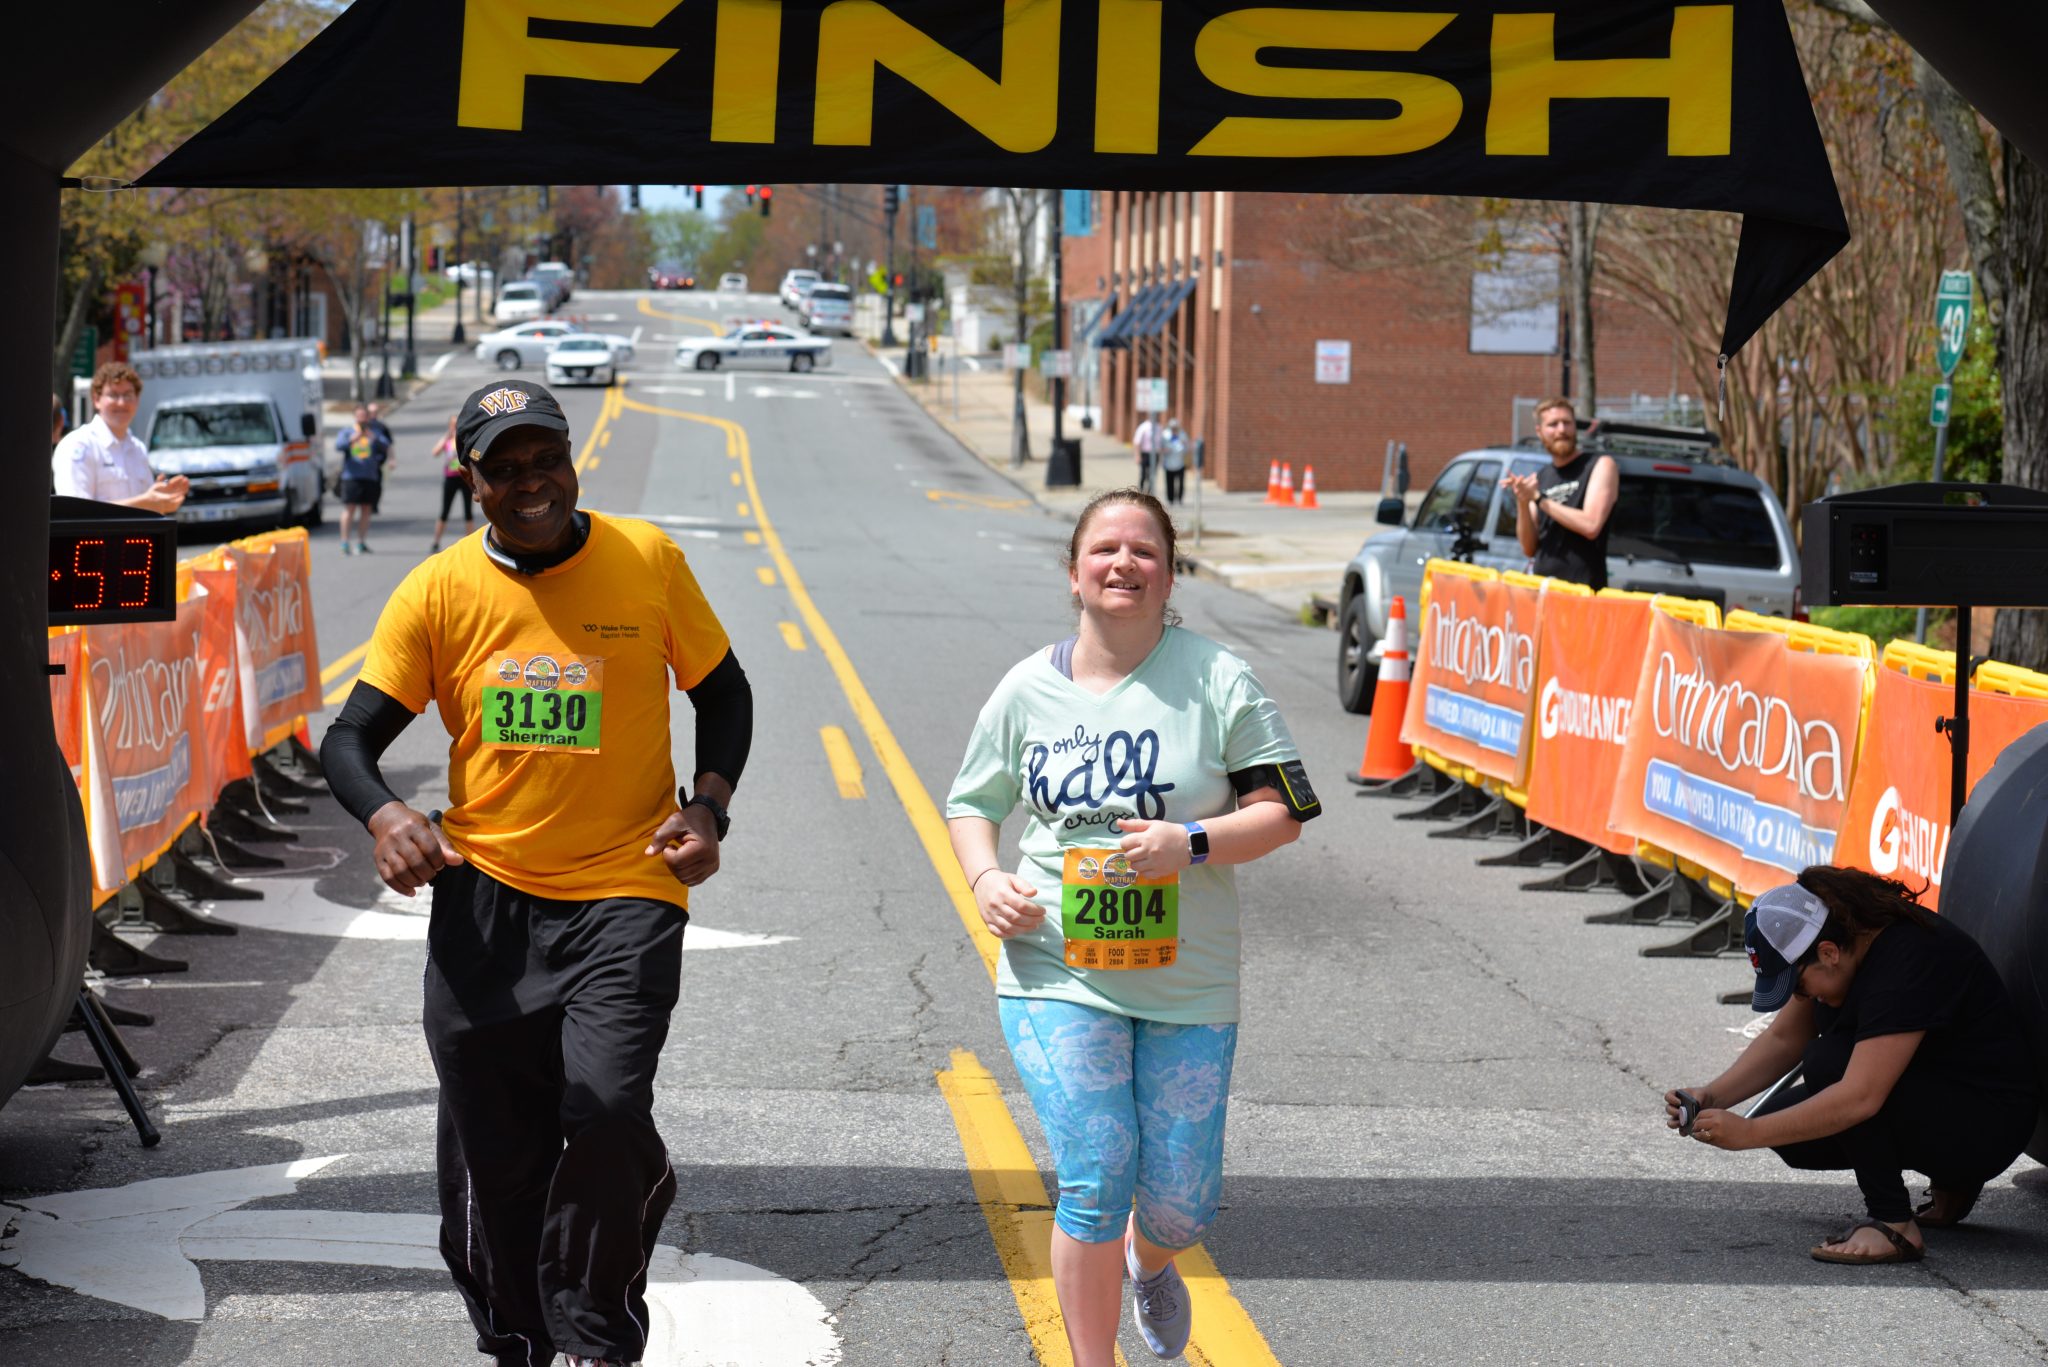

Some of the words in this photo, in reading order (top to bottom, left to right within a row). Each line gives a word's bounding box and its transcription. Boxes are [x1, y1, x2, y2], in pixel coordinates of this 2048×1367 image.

[457, 0, 1735, 158] FINISH
[478, 387, 531, 417] WF
[620, 624, 640, 632] Forest
[495, 691, 587, 731] 3130
[499, 729, 577, 745] Sherman
[1053, 724, 1102, 764] only
[1028, 728, 1175, 821] half
[1075, 888, 1166, 926] 2804
[1094, 926, 1145, 939] Sarah
[1108, 948, 1124, 957] FOOD
